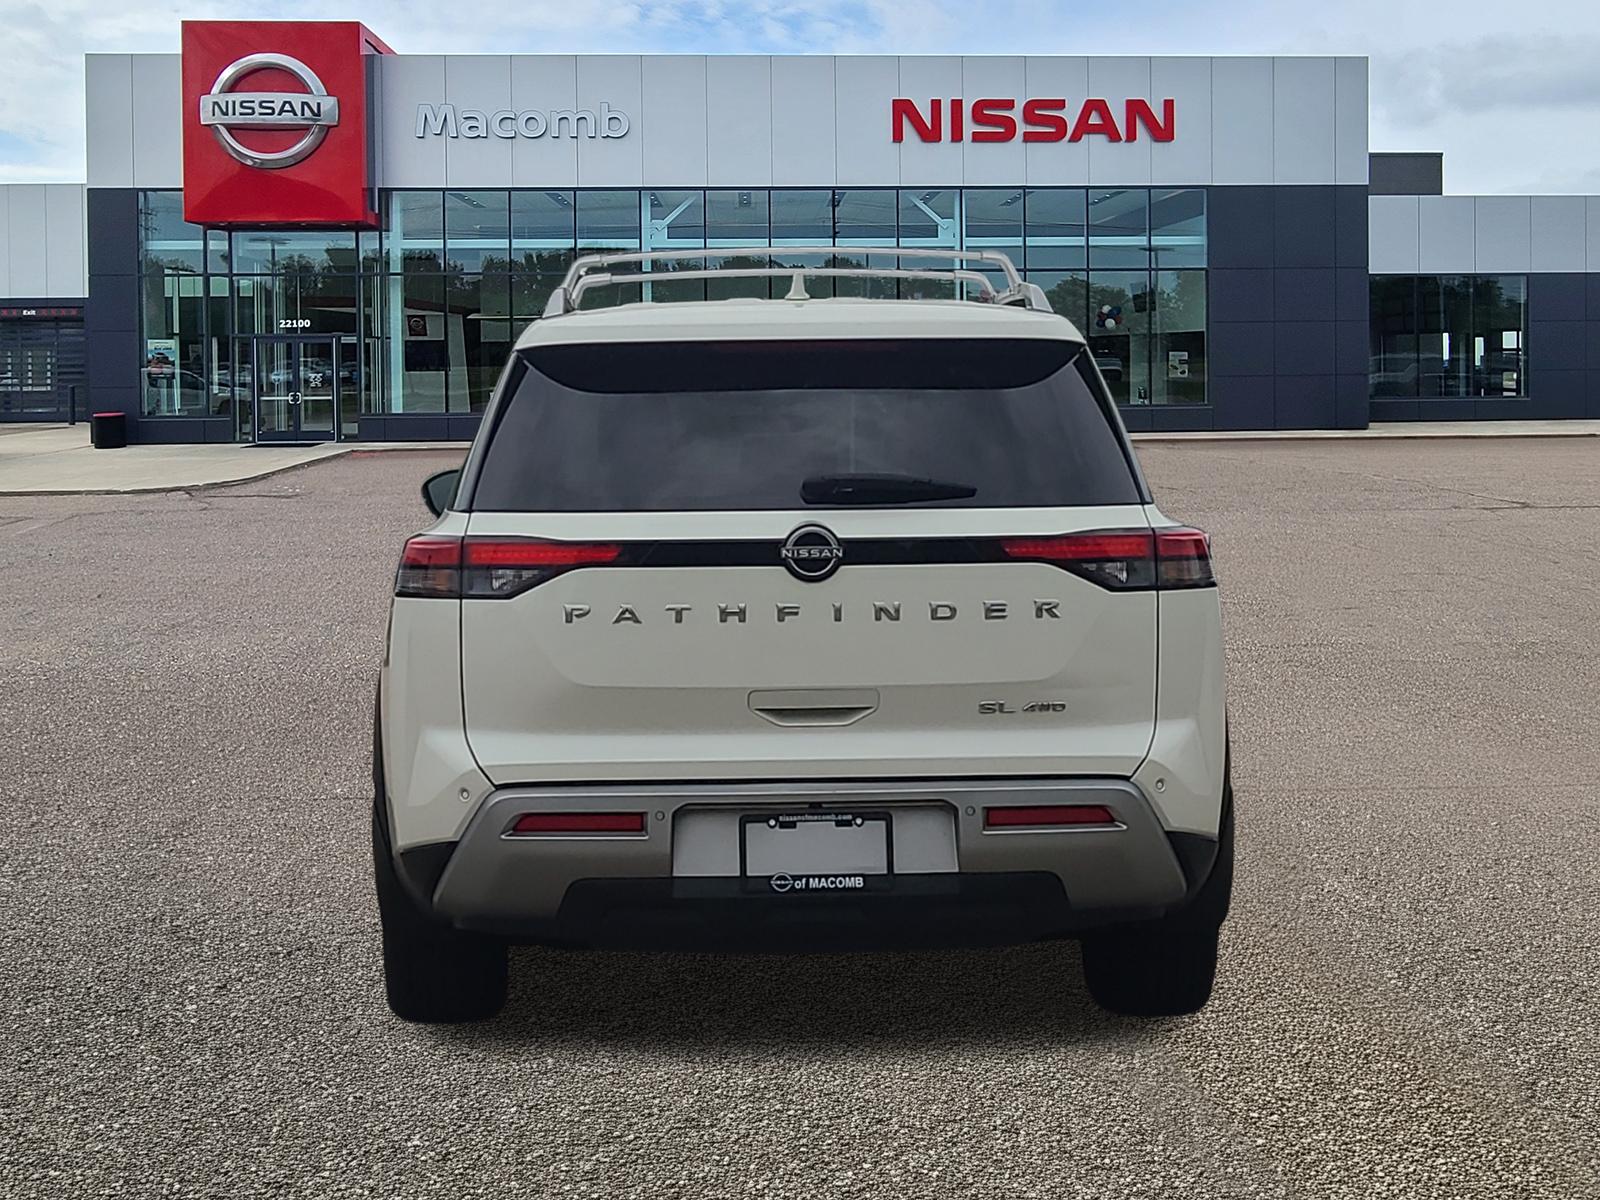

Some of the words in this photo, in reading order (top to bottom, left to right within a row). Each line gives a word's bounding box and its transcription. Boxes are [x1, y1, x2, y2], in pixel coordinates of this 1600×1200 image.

[211, 100, 321, 117] NISSAN
[415, 102, 630, 138] Macomb
[892, 98, 1175, 142] NISSAN
[279, 319, 311, 328] 22100
[781, 548, 843, 558] NISSAN
[563, 600, 1061, 624] PATHFINDER
[979, 701, 1017, 714] SL
[794, 878, 806, 889] of
[809, 877, 864, 889] MACOMB
